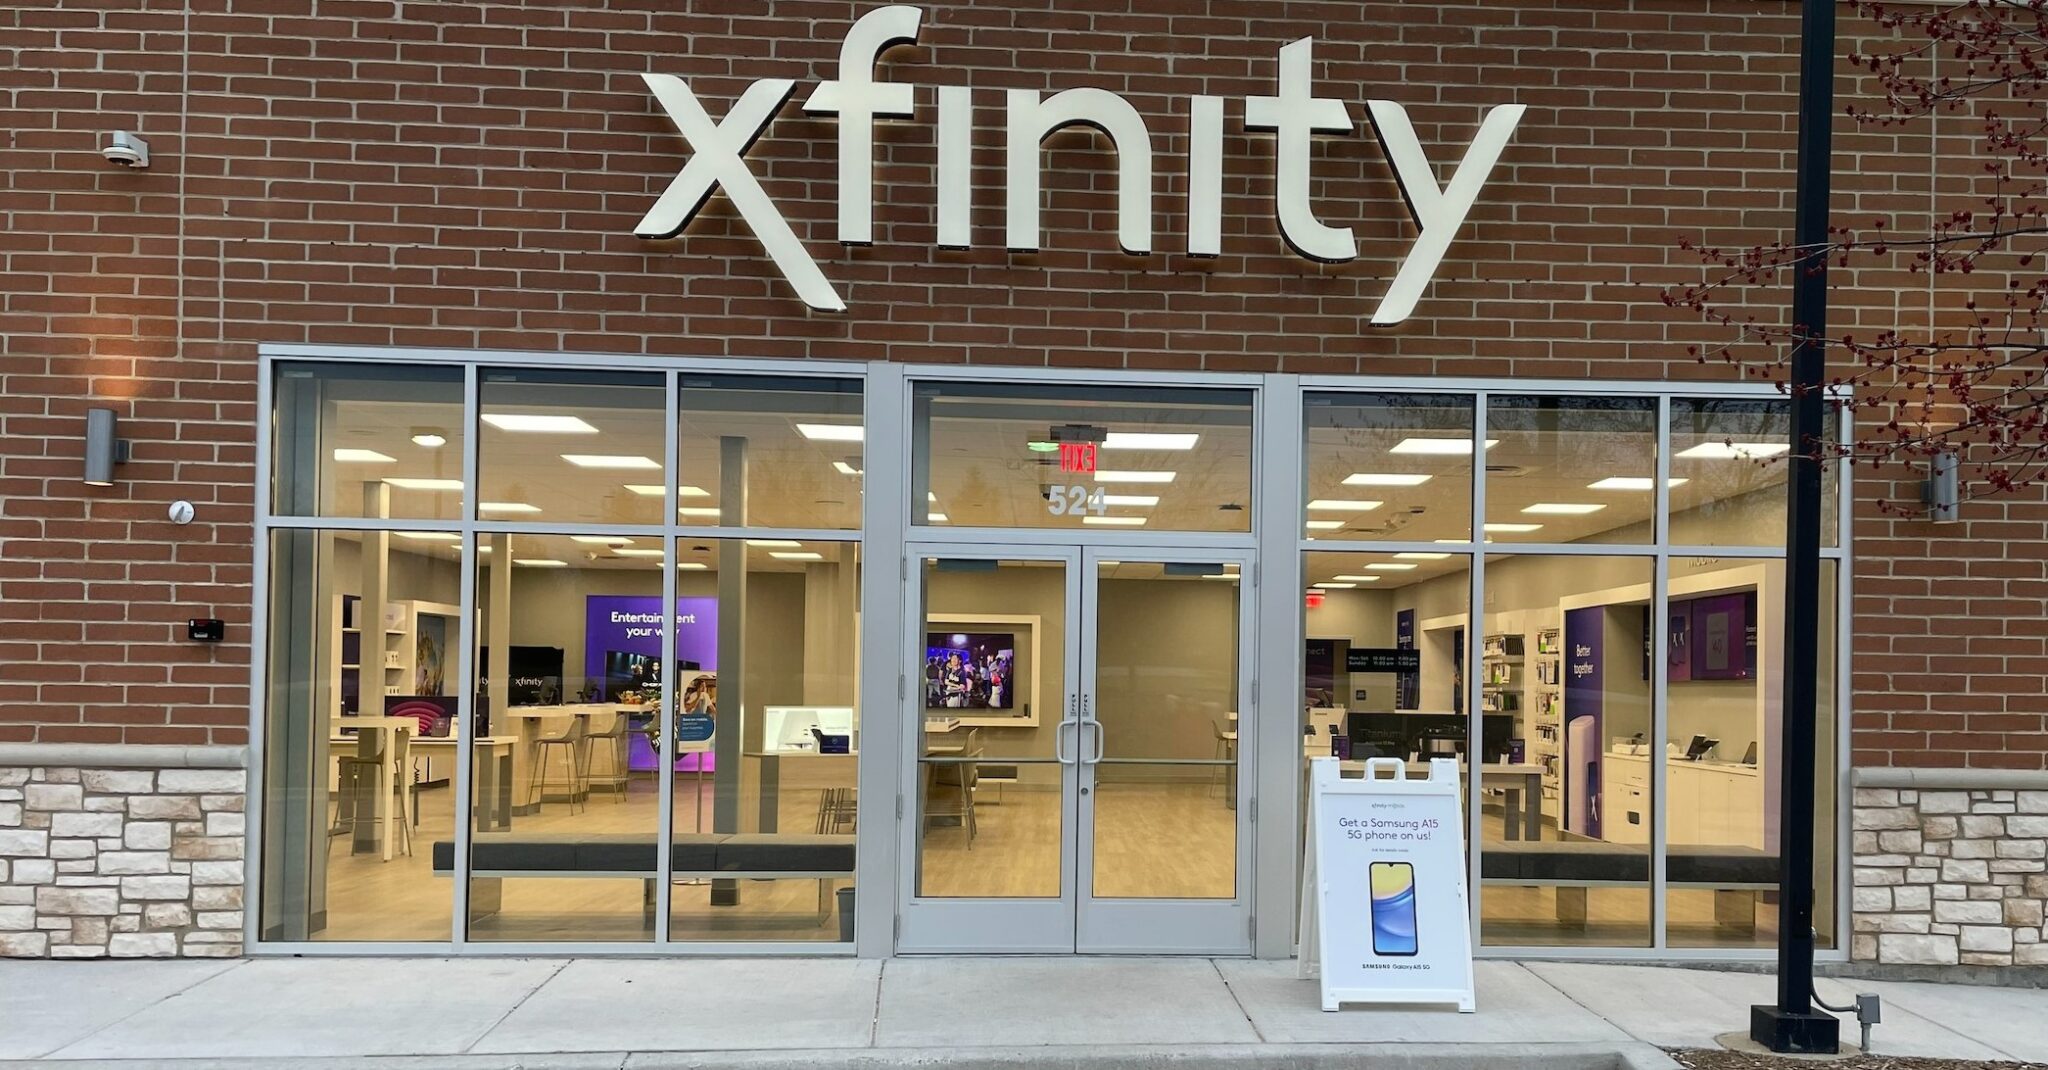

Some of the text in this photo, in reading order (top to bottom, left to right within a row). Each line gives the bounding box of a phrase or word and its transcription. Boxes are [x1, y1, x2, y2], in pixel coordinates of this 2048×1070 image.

[634, 5, 1527, 327] xfinity
[1048, 485, 1107, 516] 524
[611, 611, 696, 624] Entertainent
[626, 627, 652, 639] your
[1576, 643, 1591, 657] Better
[1573, 661, 1594, 678] together
[515, 676, 543, 687] xfinity
[1339, 817, 1439, 831] Get a Samsung A15
[1347, 829, 1431, 842] 5G phone on us!
